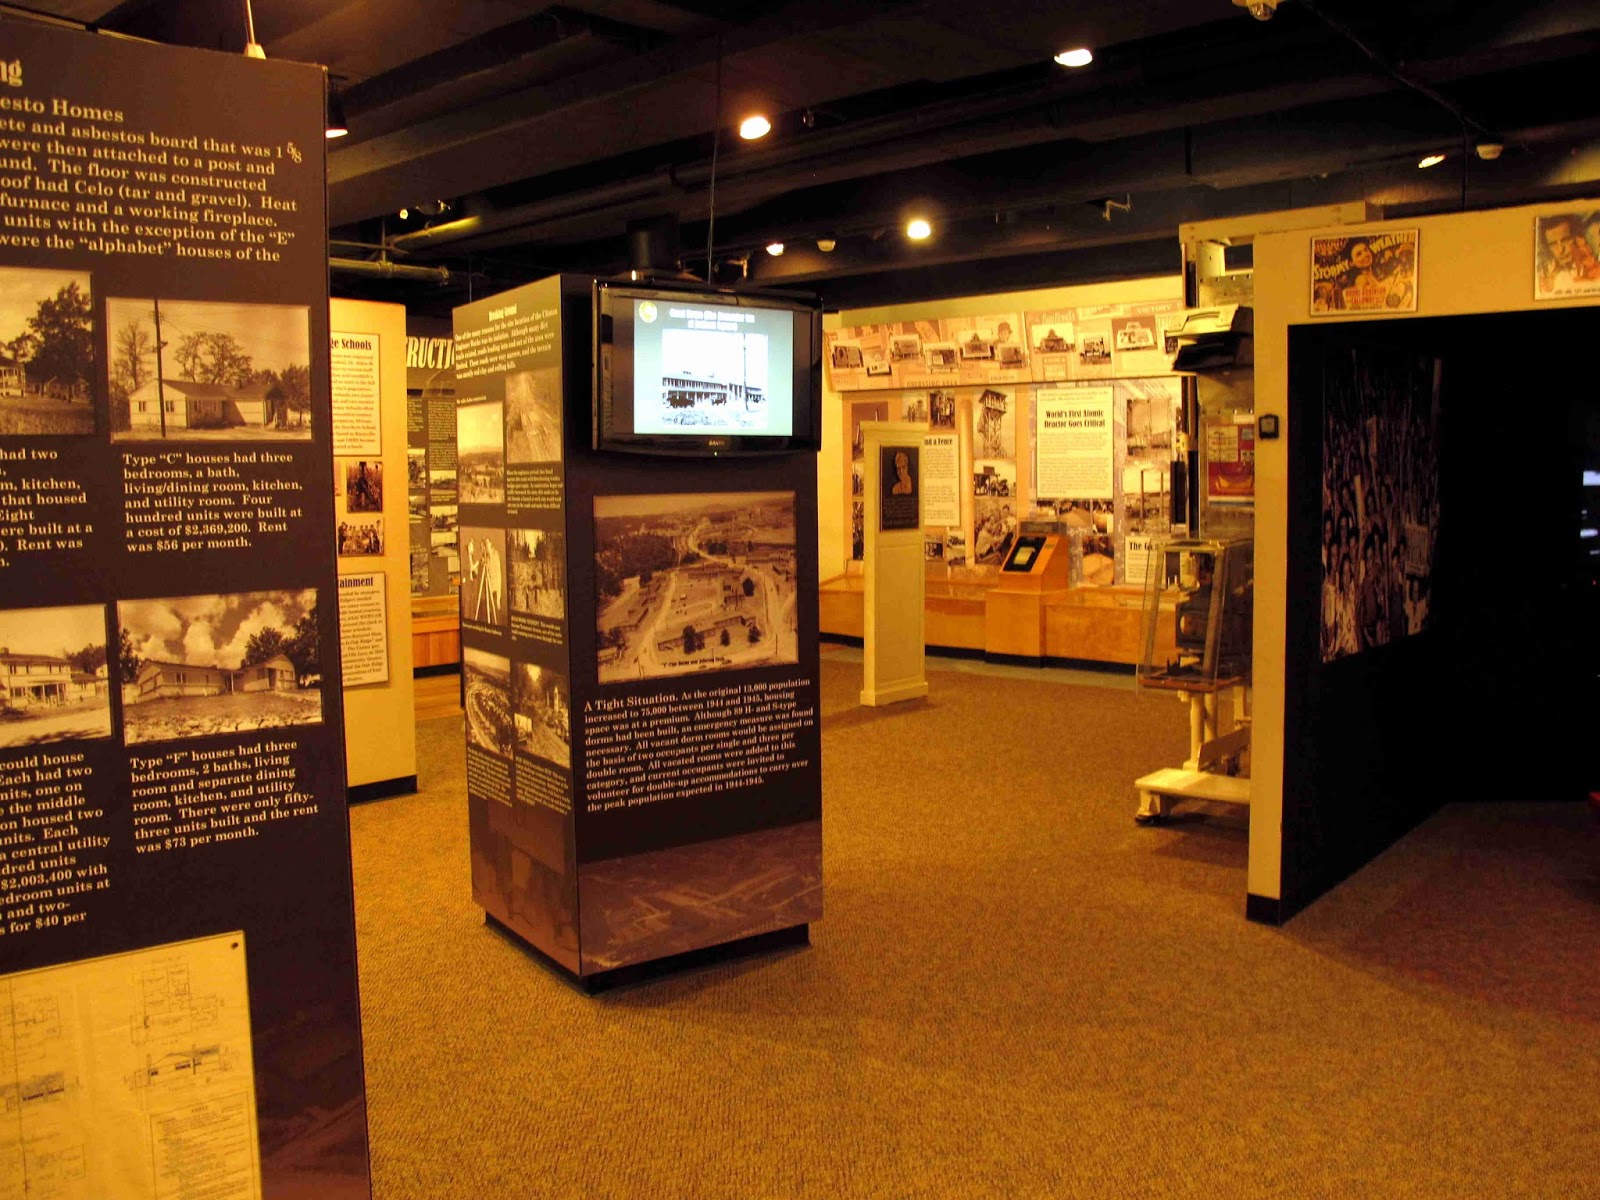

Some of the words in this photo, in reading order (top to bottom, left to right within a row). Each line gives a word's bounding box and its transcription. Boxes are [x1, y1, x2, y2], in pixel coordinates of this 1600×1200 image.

[52, 97, 124, 122] Homes
[32, 122, 65, 137] and
[72, 125, 145, 145] asbestos
[150, 131, 198, 151] board
[203, 138, 236, 155] that
[241, 145, 271, 158] was
[47, 141, 87, 158] then
[93, 148, 167, 166] attached
[173, 154, 189, 168] to
[194, 158, 202, 169] a
[208, 160, 241, 174] post
[246, 161, 275, 176] and
[36, 176, 68, 193] had
[75, 179, 113, 197] Celo
[118, 183, 150, 202] (tar
[155, 188, 186, 203] and
[261, 195, 297, 212] Heat
[4, 216, 51, 230] units
[57, 218, 96, 233] with
[102, 219, 129, 235] the
[135, 226, 215, 242] exception
[220, 227, 237, 242] of
[240, 228, 264, 244] the
[341, 338, 372, 350] Schools
[31, 449, 58, 460] two
[123, 454, 156, 469] Type
[186, 453, 230, 464] houses
[233, 452, 256, 464] had
[260, 451, 293, 463] three
[3, 493, 32, 506] that
[36, 491, 87, 505] housed
[124, 482, 209, 497] living/dining
[213, 484, 249, 494] room,
[253, 479, 302, 493] kitchen,
[126, 510, 182, 523] hundred
[187, 511, 220, 521] units
[223, 511, 254, 520] were
[257, 507, 286, 519] built
[290, 508, 301, 518] at
[126, 530, 133, 538] a
[138, 527, 164, 537] cost
[168, 524, 182, 536] of
[258, 521, 287, 533] Rent
[127, 543, 153, 552] was
[157, 539, 178, 552] $56
[182, 541, 204, 553] per
[207, 536, 251, 549] month.
[584, 701, 592, 713] A
[595, 698, 624, 713] Tight
[627, 694, 678, 707] Situation.
[681, 691, 692, 700] As
[694, 689, 707, 699] the
[709, 685, 741, 698] original
[769, 680, 810, 693] population
[585, 710, 627, 724] increased
[630, 711, 639, 719] to
[668, 704, 703, 714] between
[725, 697, 741, 708] and
[764, 693, 795, 703] housing
[585, 726, 610, 737] space
[612, 723, 629, 732] was
[631, 721, 640, 729] at
[694, 708, 732, 722] Although
[756, 704, 771, 714] and
[585, 736, 613, 746] dorms
[615, 731, 632, 742] had
[634, 730, 655, 740] been
[681, 726, 692, 734] an
[694, 720, 738, 732] emergency
[740, 716, 773, 726] measure
[775, 714, 790, 722] was
[791, 708, 813, 720] found
[636, 740, 648, 750] All
[650, 737, 678, 748] vacant
[680, 734, 703, 744] dorm
[705, 731, 730, 741] rooms
[732, 725, 756, 737] would
[758, 724, 768, 734] be
[769, 719, 802, 733] assigned
[804, 720, 813, 728] on
[43, 753, 84, 766] house
[130, 757, 163, 772] Type
[191, 749, 235, 762] houses
[238, 742, 261, 757] had
[265, 740, 297, 753] three
[133, 800, 171, 812] room,
[175, 790, 227, 807] kitchen,
[230, 784, 253, 799] and
[257, 781, 294, 796] utility
[134, 814, 172, 826] room.
[178, 806, 216, 820] There
[220, 802, 251, 814] were
[254, 795, 281, 811] only
[587, 802, 602, 812] the
[604, 798, 625, 812] peak
[628, 792, 674, 808] population
[676, 784, 713, 799] expected
[715, 784, 723, 792] in
[11, 840, 63, 859] central
[67, 836, 110, 852] utility
[136, 843, 161, 854] was
[165, 835, 186, 851] $73
[190, 835, 212, 850] per
[215, 826, 259, 843] month.
[76, 861, 107, 878] with
